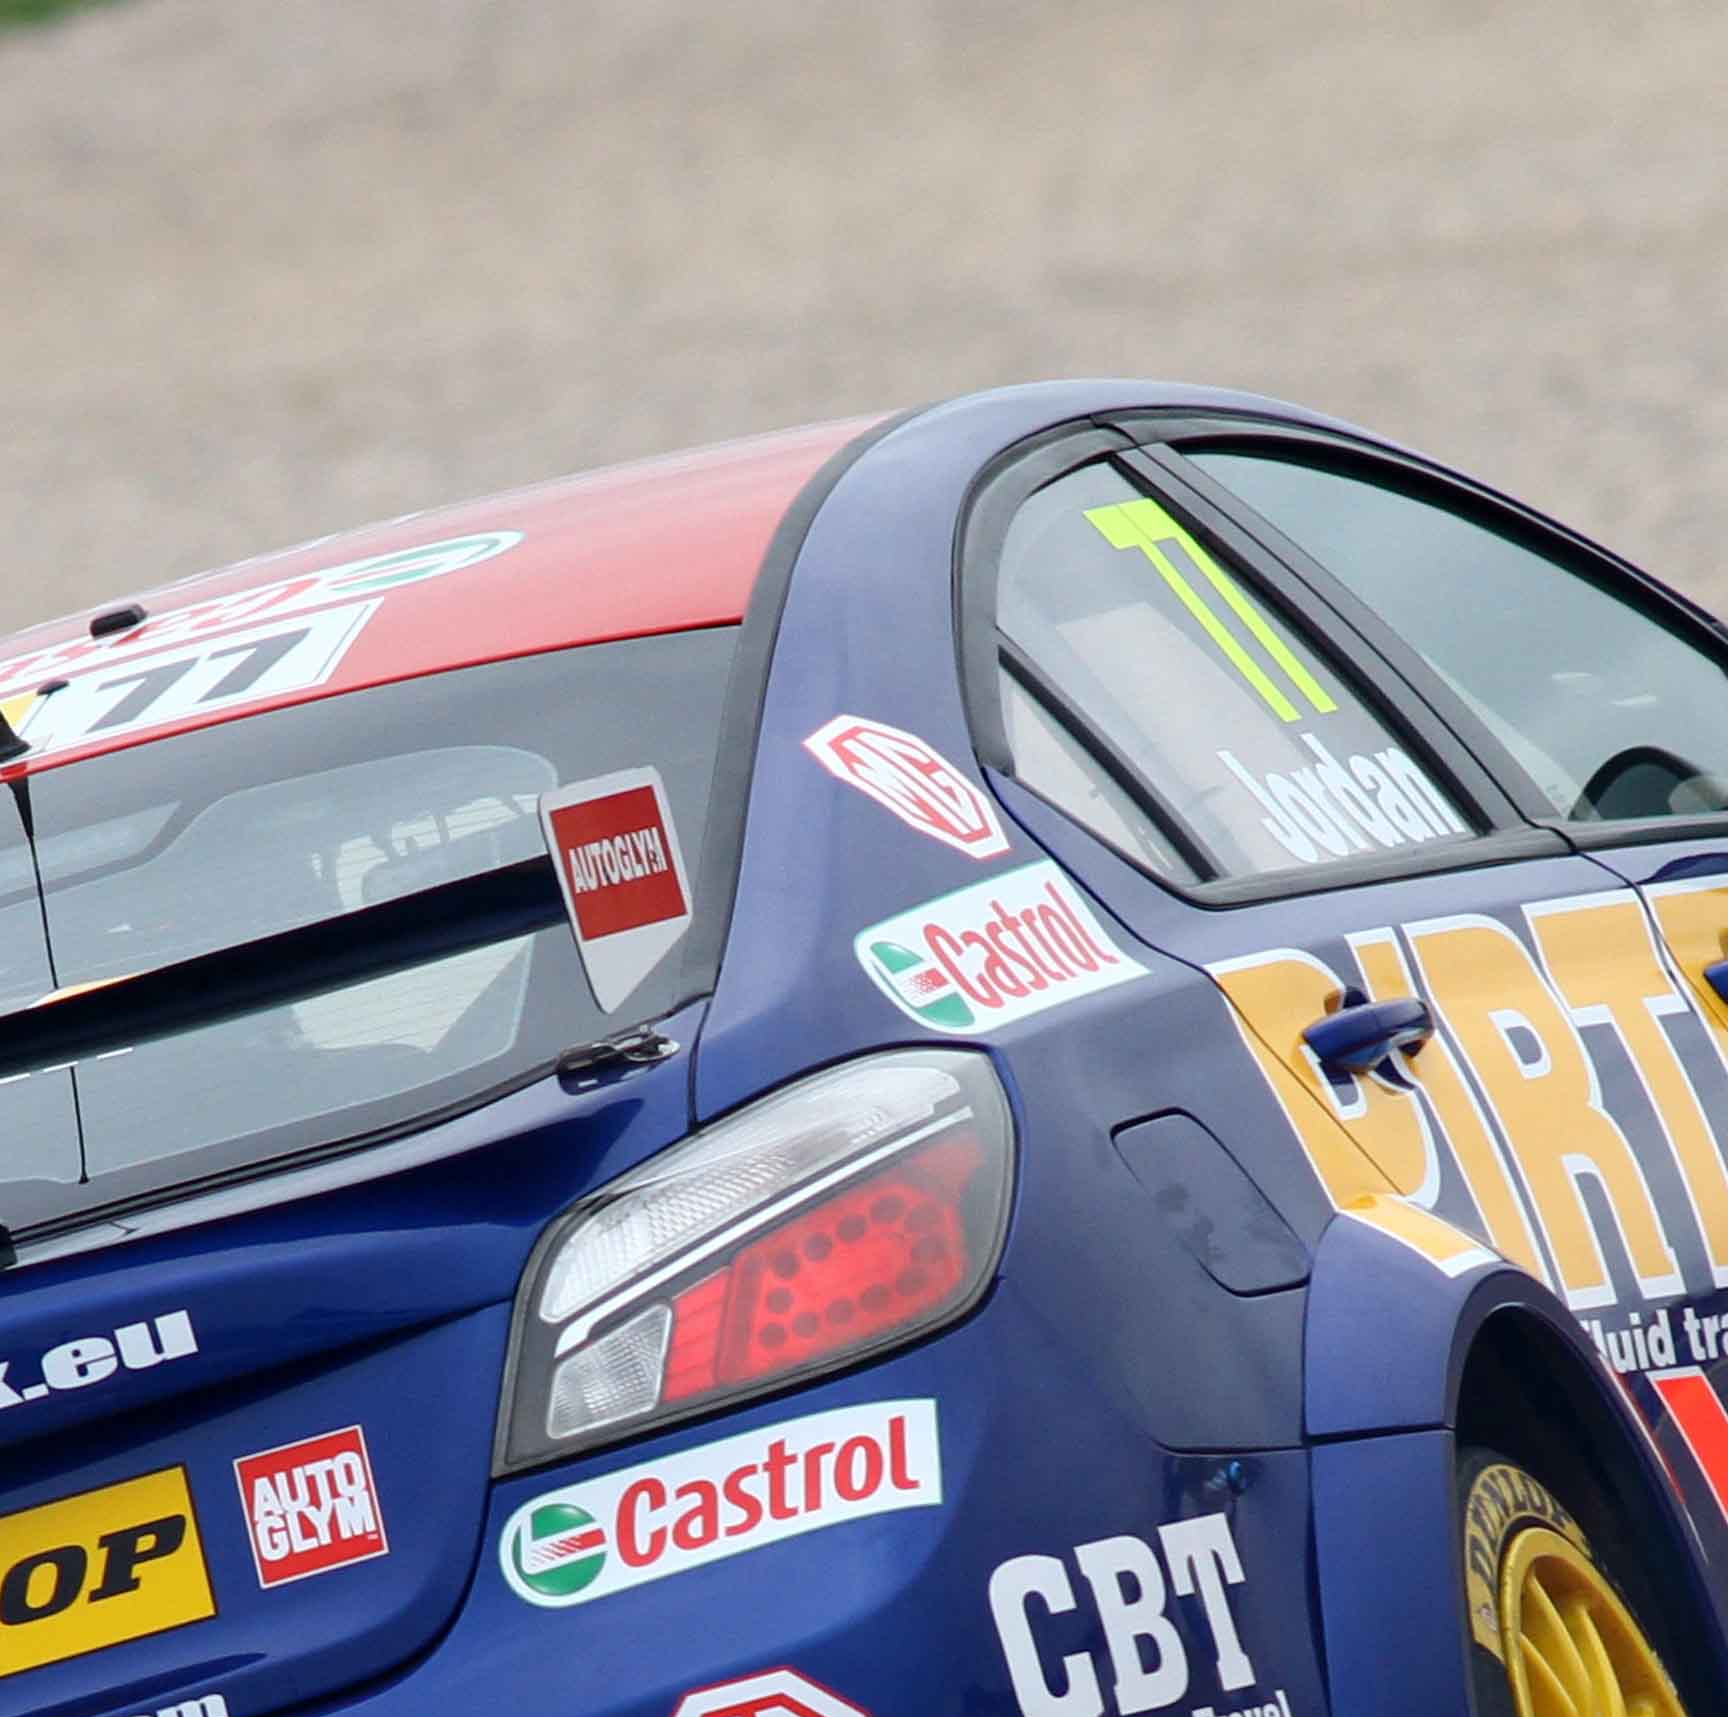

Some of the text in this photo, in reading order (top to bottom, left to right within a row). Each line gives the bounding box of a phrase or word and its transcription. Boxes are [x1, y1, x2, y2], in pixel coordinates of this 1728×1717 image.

[1083, 496, 1339, 723] 77
[85, 626, 314, 735] 77
[1215, 732, 1466, 864] Jordan
[923, 879, 1120, 1009] Castrol
[253, 1445, 365, 1519] AUTO
[256, 1484, 377, 1562] GLYM
[616, 1415, 920, 1569] Castrol
